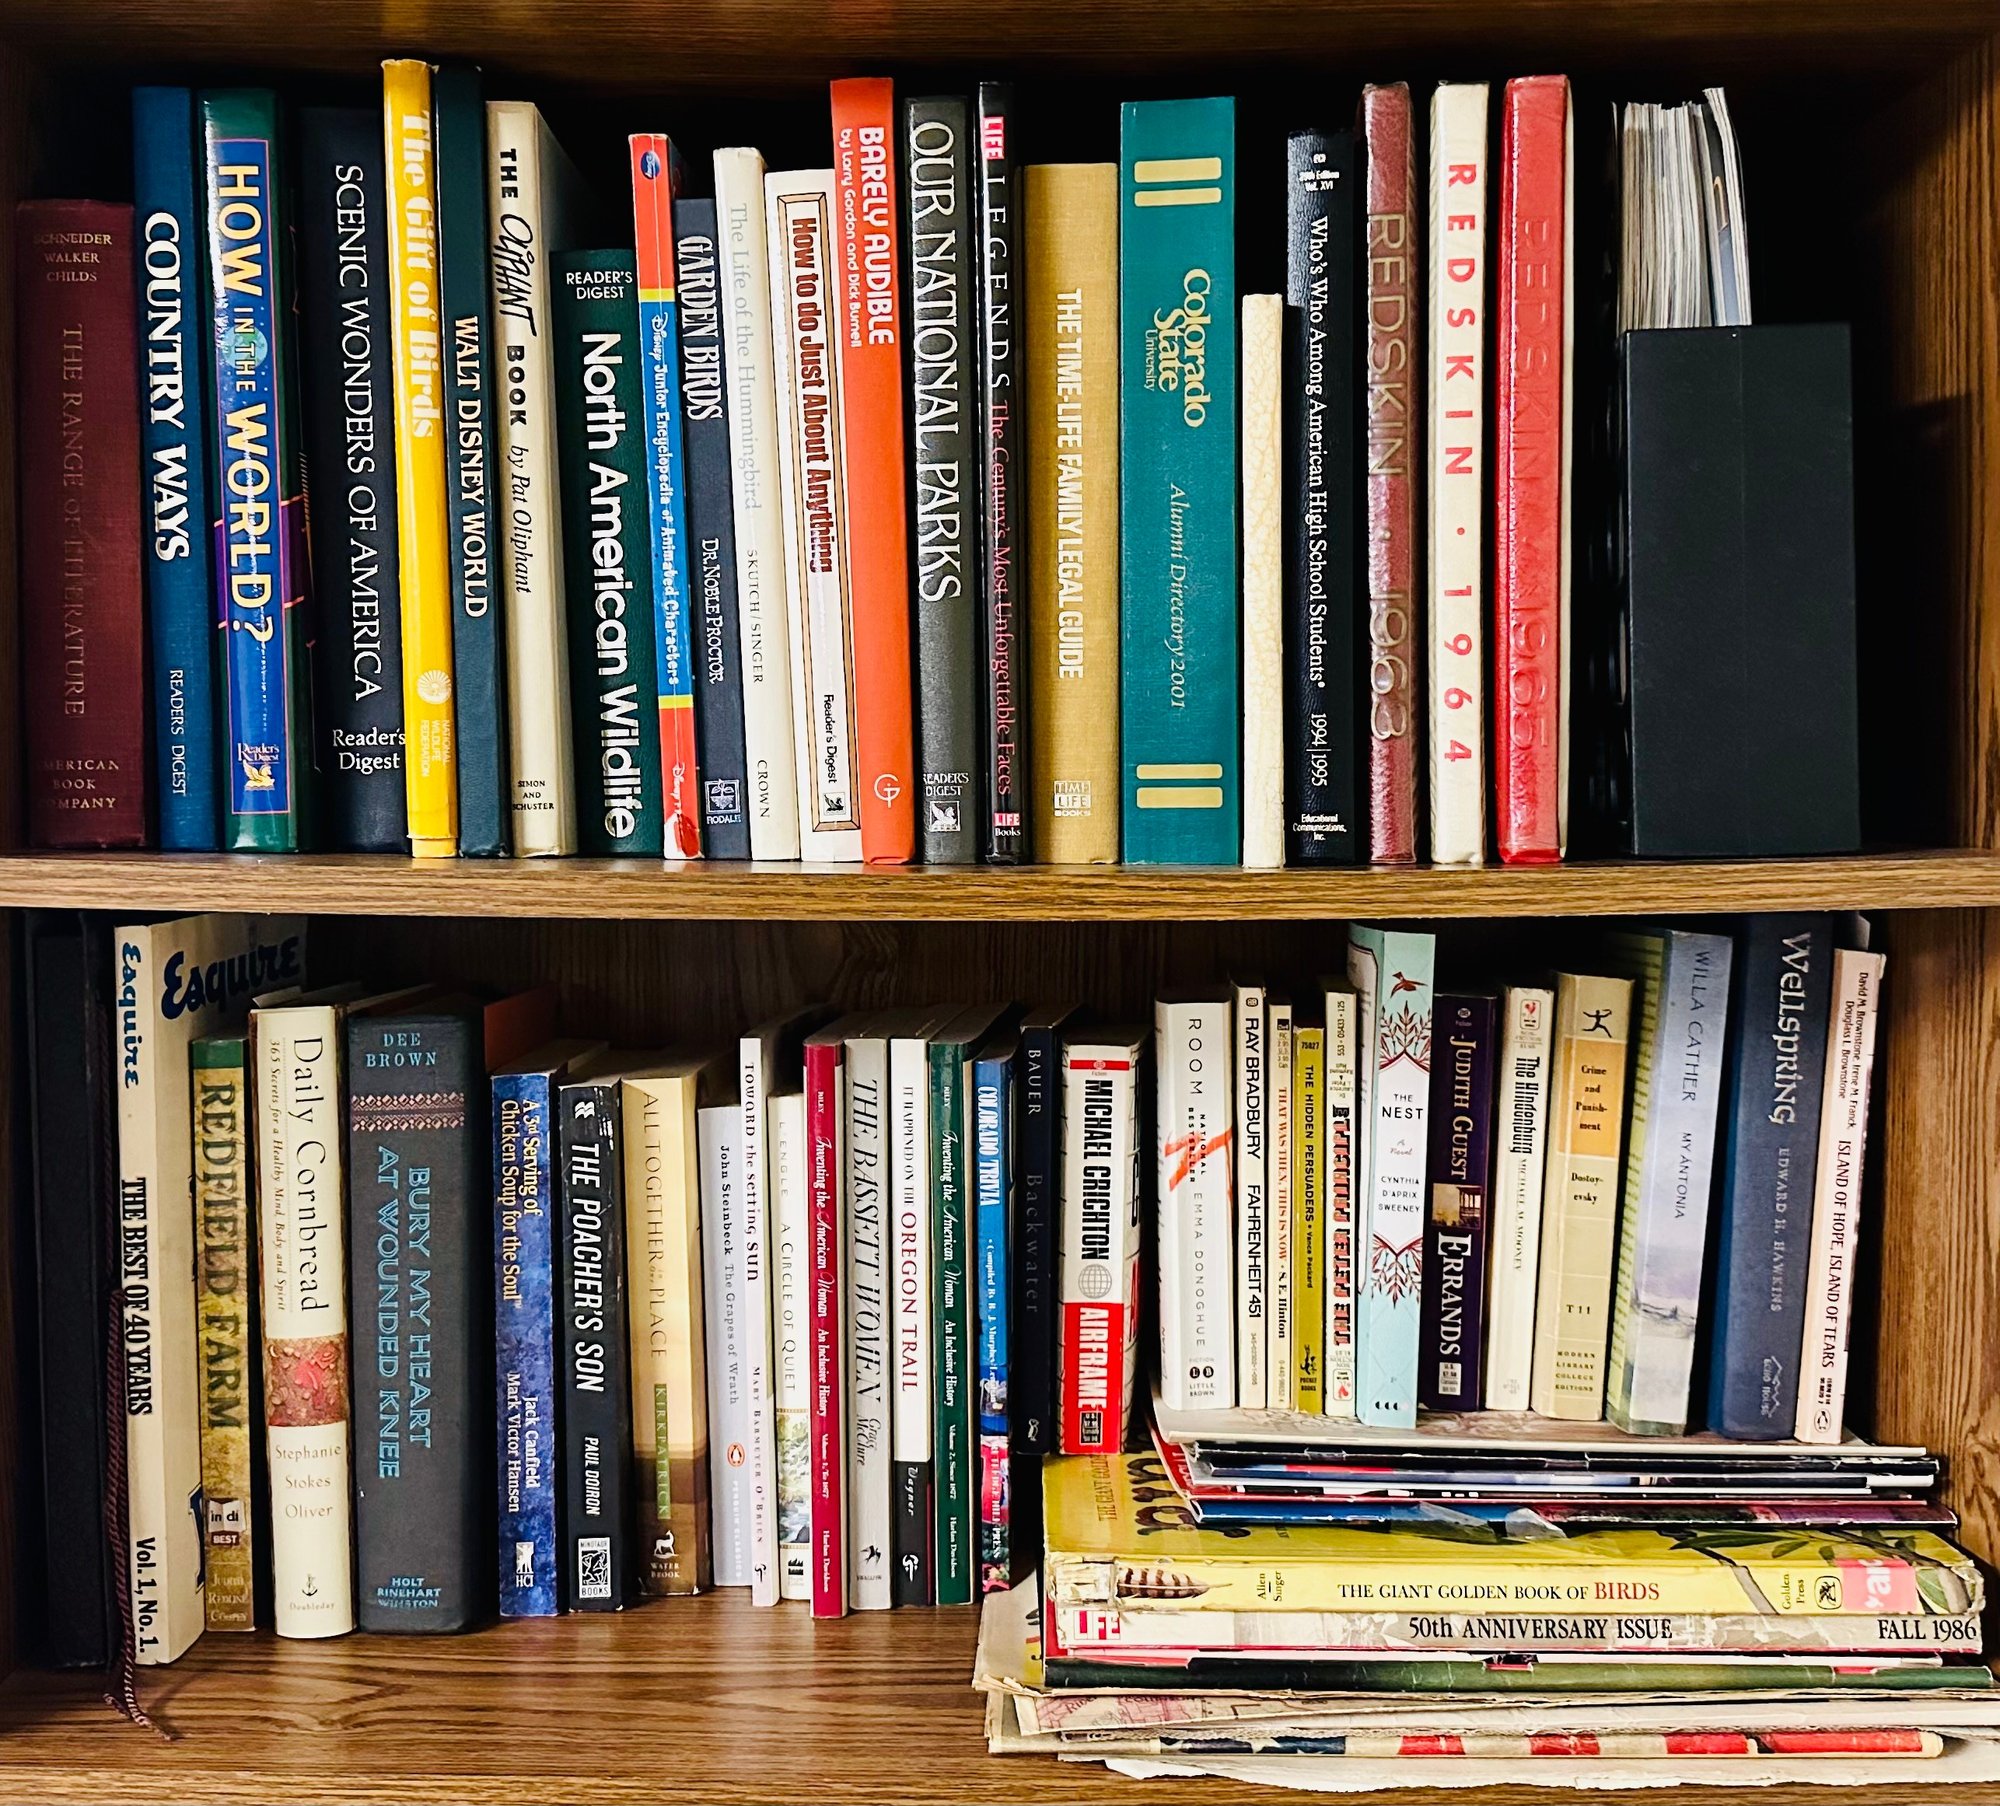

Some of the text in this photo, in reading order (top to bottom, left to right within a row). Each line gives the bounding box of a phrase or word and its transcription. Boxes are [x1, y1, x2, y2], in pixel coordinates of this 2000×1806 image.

[984, 118, 1004, 159] LIFE
[402, 110, 441, 437] The Gift of Birds
[566, 271, 633, 285] READER'S
[858, 126, 895, 345] BARELY AUDIBLE
[576, 286, 624, 300] DIGEST
[678, 235, 723, 420] GARDEN BIRDS
[145, 212, 190, 561] COUNTRY WAYS
[729, 203, 762, 509] The Life of the Hummingbird
[910, 122, 962, 601] OUR NATIONAL PARKS
[1144, 329, 1158, 392] University
[1154, 308, 1186, 392] State
[1183, 268, 1212, 428] Colorado
[218, 164, 273, 642] HOW IN THE WORLD?
[335, 165, 382, 701] SCENIC WONDERS OF AMERICA
[792, 217, 834, 573] How to do Just About Anything
[455, 316, 487, 618] WALT DISNEY WORLD
[1056, 289, 1083, 679] THE TIME-LIFE FAMILY LEGAL GUIDE
[1368, 213, 1408, 740] REDSKIN 1963
[1444, 163, 1477, 762] REDSKIN 1964
[582, 334, 642, 838] North American Wildlife
[1164, 483, 1191, 709] Alumni Directory 2001
[332, 727, 406, 747] Reader's
[339, 752, 400, 775] Digest
[757, 760, 770, 818] CROWN
[994, 813, 1020, 826] LIFE
[995, 828, 1021, 837] Books
[118, 942, 143, 1090] Esquire
[365, 1053, 436, 1067] BROWN
[382, 1033, 422, 1047] DEE
[1189, 1018, 1203, 1095] ROOM
[1682, 951, 1710, 1102] WILLA CATHER
[1305, 1065, 1314, 1088] THE
[1305, 1094, 1314, 1138] HIDDEN
[1383, 1106, 1423, 1120] NEST
[1395, 1094, 1413, 1102] THE
[1450, 1036, 1476, 1109] JUDITH
[1581, 1065, 1607, 1075] Crime
[1083, 1079, 1113, 1159] MICHAEL
[1450, 1115, 1474, 1180] GUEST
[288, 1037, 329, 1312] Daily Cornbread
[1026, 1050, 1043, 1312] BAUER Backwater
[1082, 1166, 1111, 1260] CRICHTON
[1246, 1018, 1261, 1318] RAY BRADBURY FAHRENHEIT 451
[1305, 1144, 1314, 1222] PERSUADERS
[1378, 1204, 1420, 1213] SWEENEY
[1381, 1176, 1419, 1184] CYNTHIA
[200, 1080, 243, 1432] REDFIELD FARM
[571, 1144, 604, 1392] THE POACHER'S SON
[643, 1092, 667, 1358] ALL TOGETHER PLACE
[852, 1079, 881, 1402] THE BASSETT WOMEN
[1194, 1192, 1205, 1347] EMMA DONOGHUE
[122, 1177, 152, 1415] THE BEST OF 40 YEARS
[377, 1145, 400, 1479] AT WOUNDED KNEE
[408, 1167, 432, 1449] BURY MY HEART
[720, 1145, 739, 1405] John Steinbeck The Grapes of Wrath
[1437, 1232, 1472, 1356] ERRANDS
[1078, 1307, 1109, 1409] AIRFRAME
[285, 1475, 332, 1489] Stokes
[507, 1374, 522, 1513] Mark Victor Hansen
[523, 1396, 540, 1488] Jack Canfield
[585, 1437, 600, 1516] PAUL DOIRON
[655, 1387, 668, 1513] KIRKPATRICK
[285, 1504, 333, 1520] Oliver
[581, 1587, 609, 1596] BOOKS
[1073, 1610, 1121, 1640] LIFE
[1257, 1572, 1267, 1600] Allen
[1338, 1582, 1660, 1601] THE GIANT GOLDEN BOOK OF BIRDS
[1409, 1616, 1673, 1640] 50th ANNIVERSARY ISSUE
[1782, 1573, 1791, 1611] Golden
[1796, 1578, 1805, 1605] Press
[1878, 1618, 1977, 1640] FALL 1986
